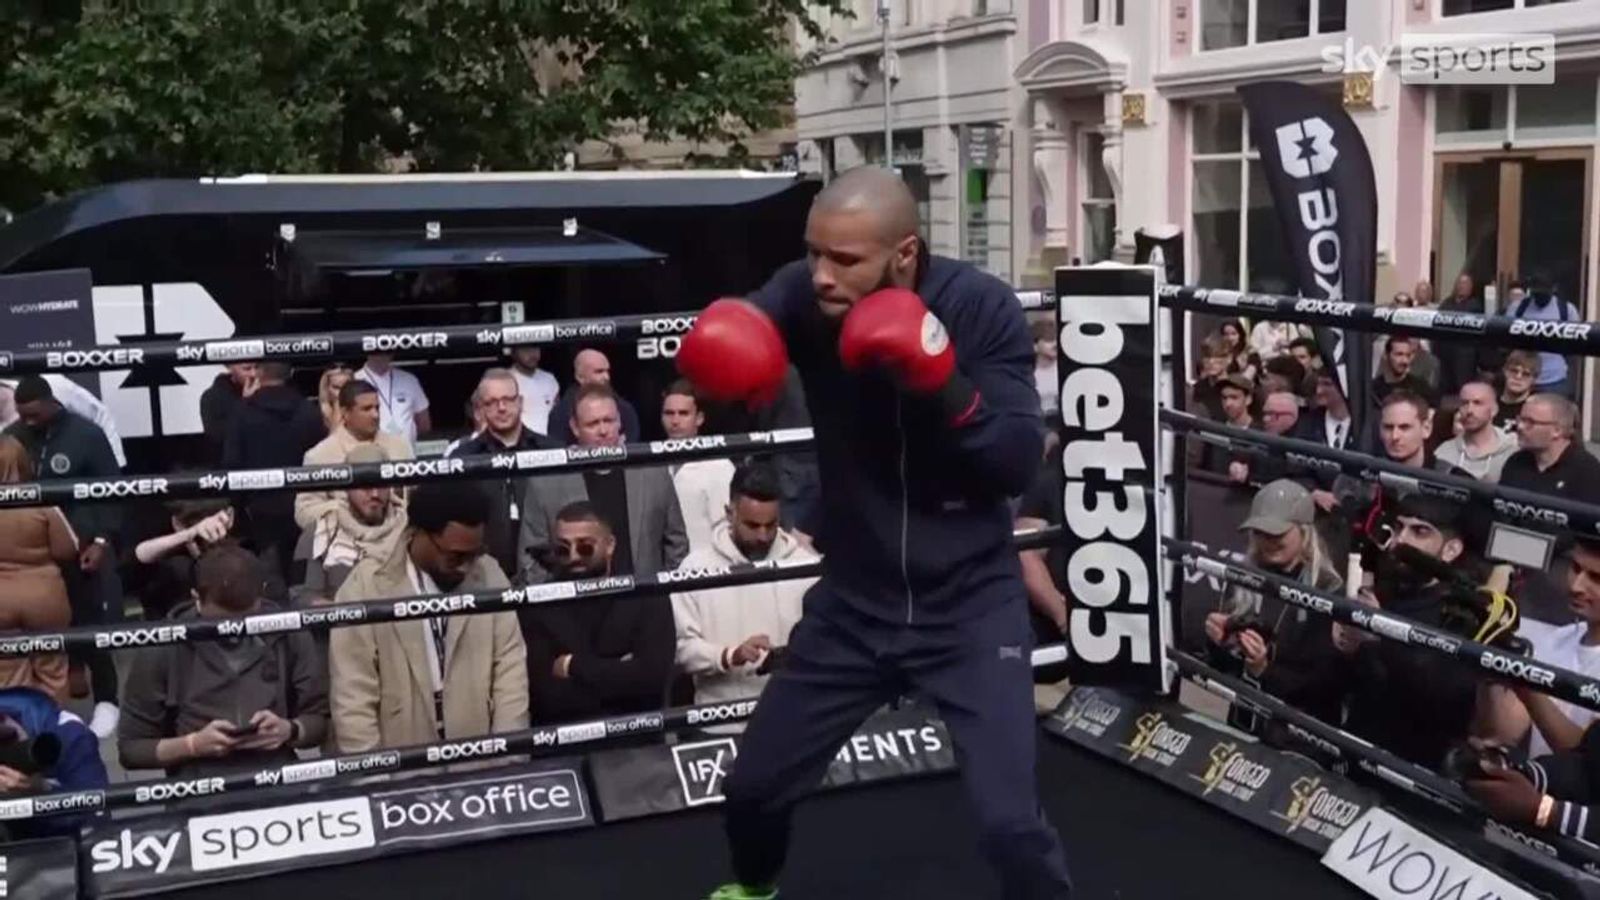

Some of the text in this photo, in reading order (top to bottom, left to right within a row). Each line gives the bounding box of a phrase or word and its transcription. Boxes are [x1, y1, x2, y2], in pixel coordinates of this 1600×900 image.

[1295, 298, 1356, 317] BOXXER
[477, 329, 501, 345] sky
[555, 325, 576, 339] box
[577, 322, 614, 336] office
[1509, 319, 1592, 340] BOXXER
[176, 345, 204, 361] sky
[266, 341, 291, 354] box
[292, 338, 330, 353] office
[362, 332, 449, 352] BOXXER
[47, 348, 144, 368] BOXXER
[650, 435, 727, 454] BOXXER
[380, 457, 465, 479] BOXXER
[492, 454, 515, 469] sky
[568, 448, 589, 460] box
[590, 446, 623, 458] office
[74, 478, 169, 499] BOXXER
[199, 473, 228, 490] sky
[287, 469, 312, 482] box
[312, 468, 349, 481] office
[1060, 295, 1151, 665] bet365
[0, 486, 37, 500] office
[501, 588, 526, 604] sky
[576, 580, 598, 593] box
[599, 577, 631, 591] office
[394, 594, 476, 617] BOXXER
[217, 620, 244, 636] sky
[302, 611, 326, 624] box
[327, 608, 363, 621] office
[0, 637, 60, 653] ox office
[95, 625, 188, 649] BOXXER
[1480, 651, 1556, 688] BOXXER
[533, 730, 558, 746] sky
[608, 720, 627, 733] box
[629, 716, 661, 730] office
[427, 738, 508, 762] BOXXER
[254, 769, 281, 786] sky
[337, 760, 361, 773] box
[362, 754, 397, 769] office
[689, 749, 727, 796] IFX
[135, 776, 226, 802] BOXXER
[35, 799, 61, 812] box
[62, 793, 101, 808] office
[91, 783, 571, 874] sky sports box office
[1347, 820, 1502, 900] WOW
